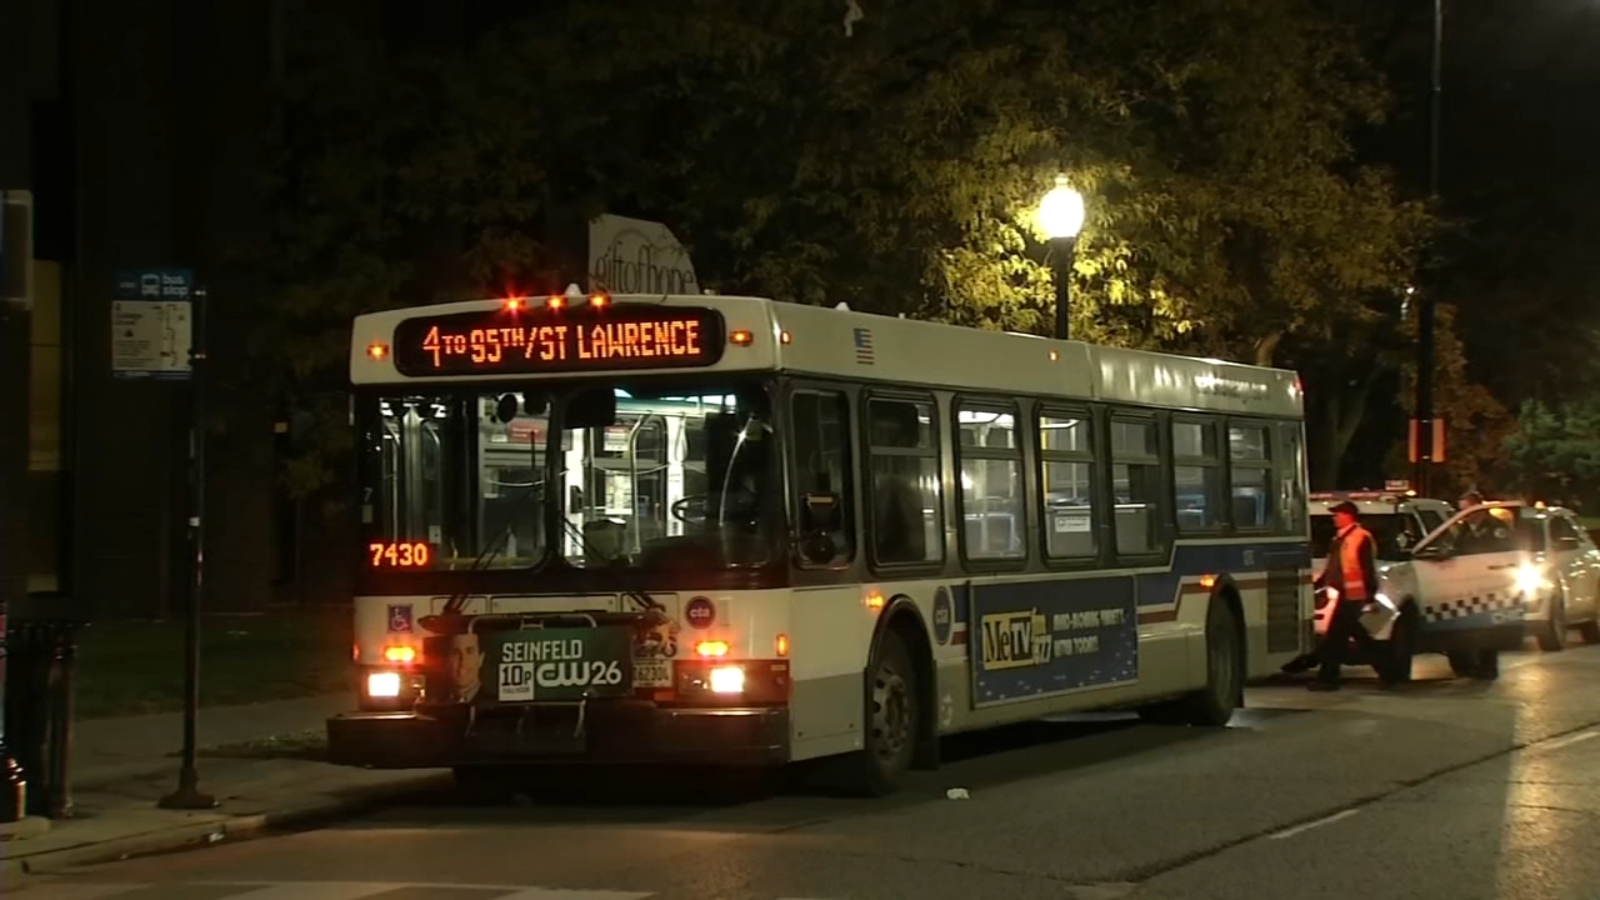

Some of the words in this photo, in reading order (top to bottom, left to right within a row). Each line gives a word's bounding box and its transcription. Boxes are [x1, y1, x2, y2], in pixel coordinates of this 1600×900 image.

[577, 320, 701, 359] LAWRENCE
[370, 543, 428, 566] 7430
[502, 639, 583, 662] SEINFELD
